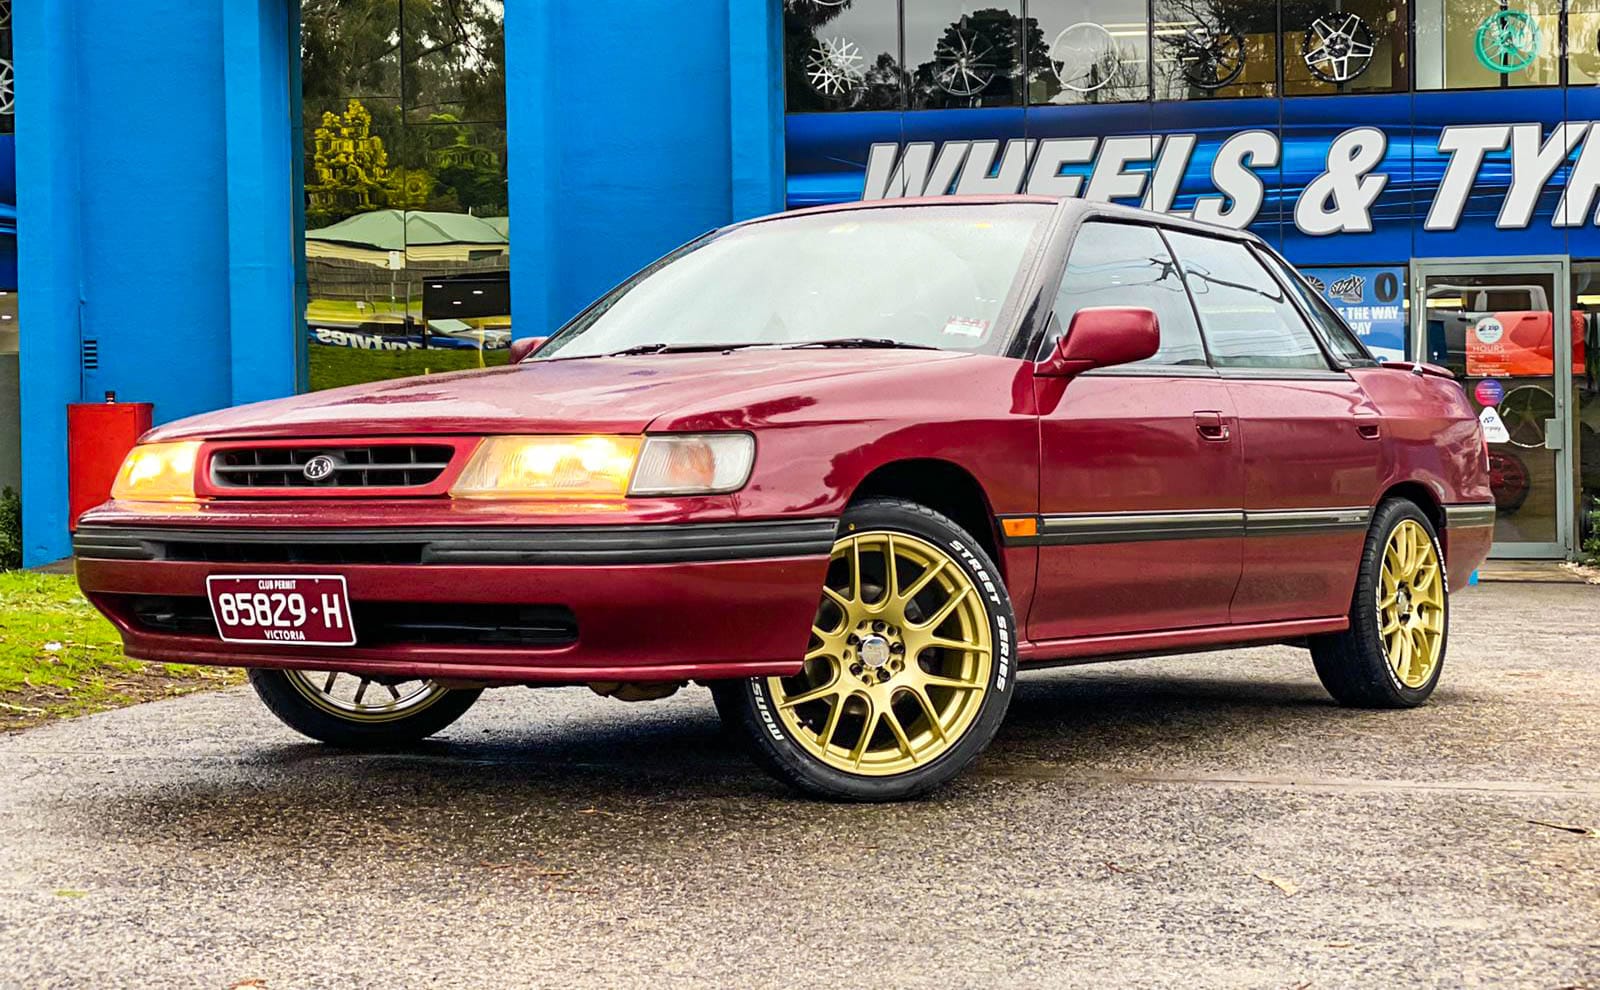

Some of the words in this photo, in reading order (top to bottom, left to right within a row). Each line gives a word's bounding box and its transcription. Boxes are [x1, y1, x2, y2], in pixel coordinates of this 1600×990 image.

[862, 129, 1281, 230] WHEELS
[1294, 126, 1388, 236] &
[1346, 306, 1369, 320] THE
[1371, 306, 1399, 320] WAY
[258, 580, 273, 590] CLUB
[274, 580, 296, 590] PERMIT
[949, 539, 1001, 606] STREET
[996, 615, 1010, 692] SERIES
[264, 629, 306, 641] VICTORIA
